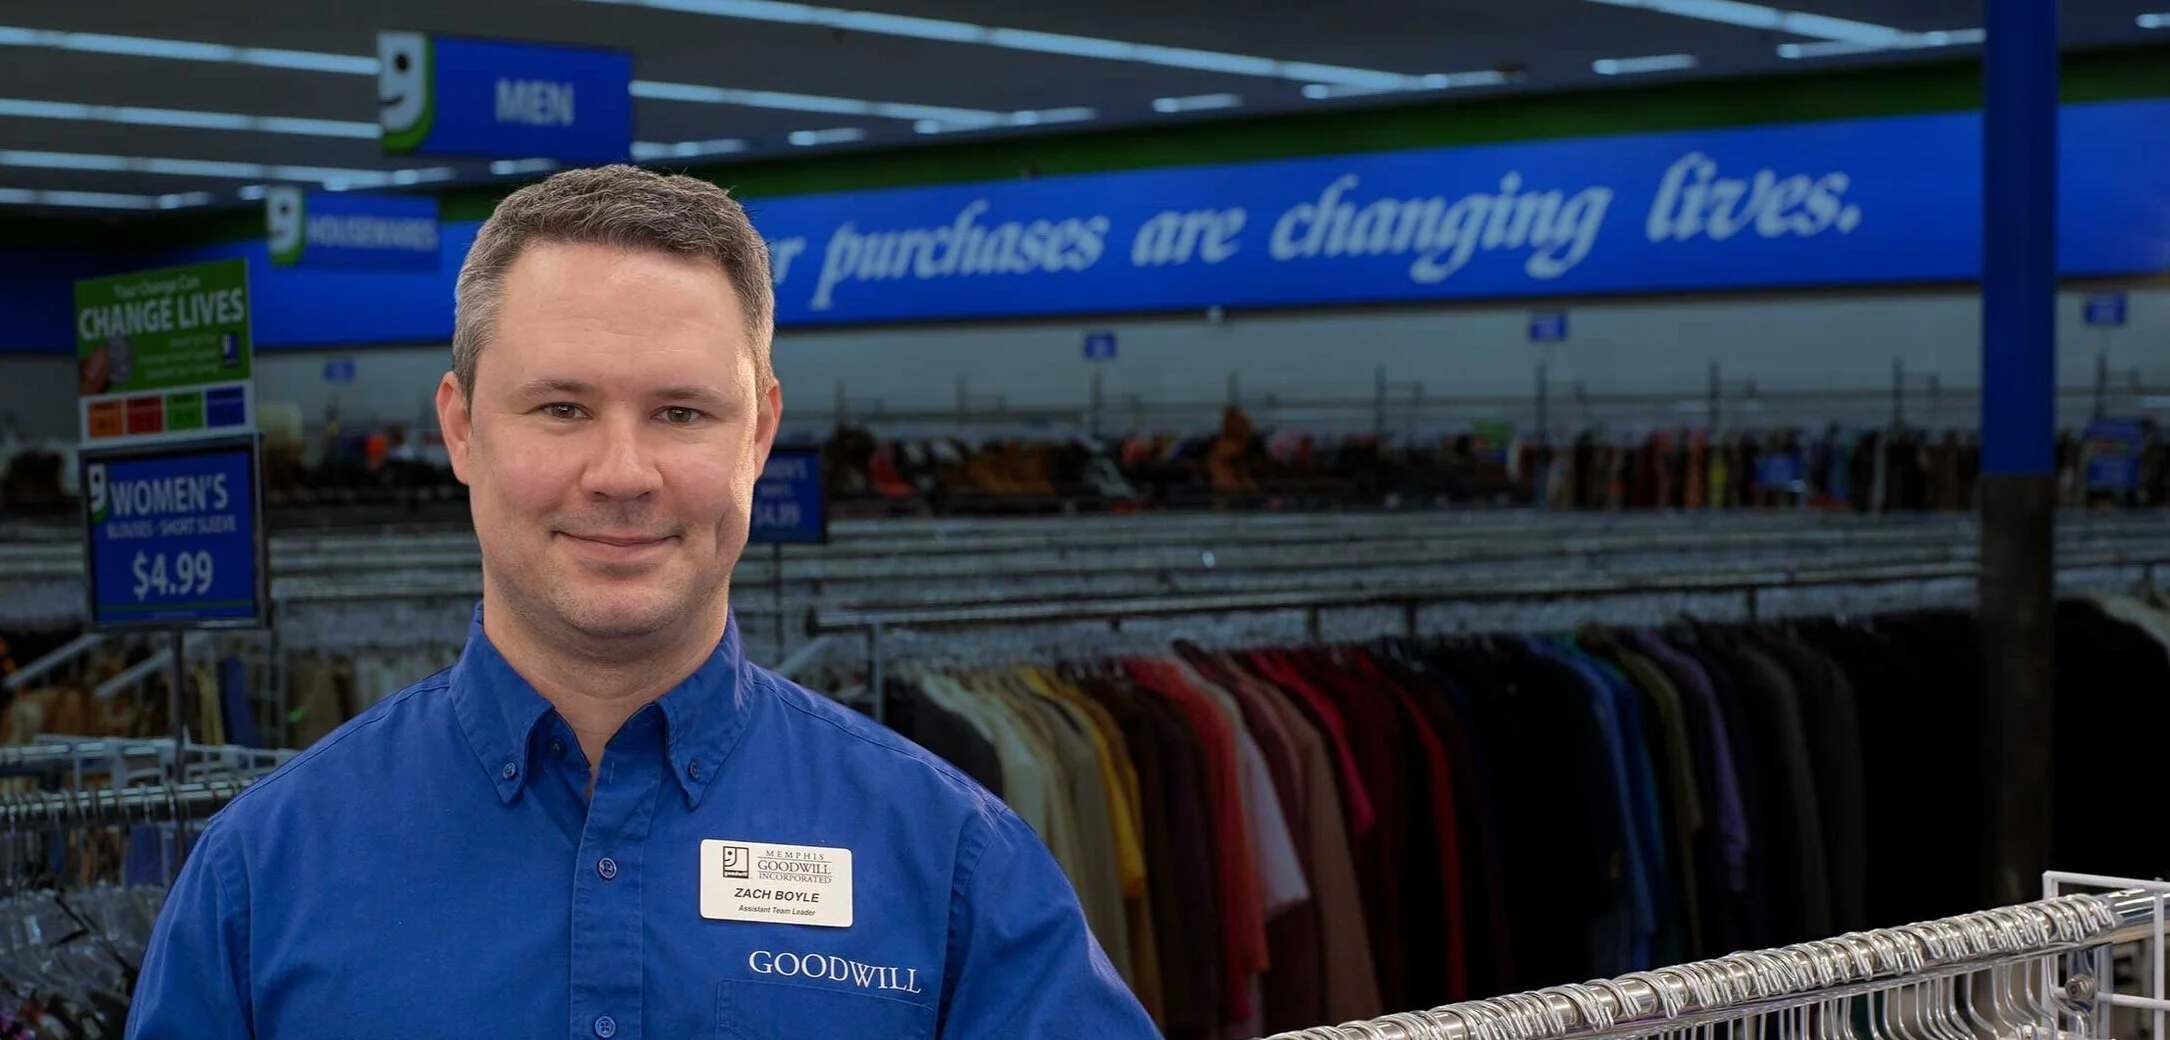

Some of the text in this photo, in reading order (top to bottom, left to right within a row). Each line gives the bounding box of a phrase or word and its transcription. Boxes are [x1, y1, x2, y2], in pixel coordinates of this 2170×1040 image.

[494, 77, 576, 127] MEN
[810, 199, 1110, 311] purchases
[1130, 206, 1247, 268] are
[1268, 171, 1614, 283] changing
[1646, 151, 1862, 243] lives.
[79, 287, 245, 342] CHANGE LIVES
[110, 473, 229, 518] WOMEN'S
[159, 517, 196, 537] SHORT
[197, 515, 237, 535] SLEEVE
[132, 549, 214, 601] $4.99
[757, 859, 832, 875] GOODWILL
[766, 849, 825, 861] MEMPHIS
[758, 871, 833, 884] INCORPORATED
[734, 888, 820, 903] ZACH BOYLE
[738, 904, 816, 917] Assistant Team Leader
[748, 950, 922, 994] GOODWILL
